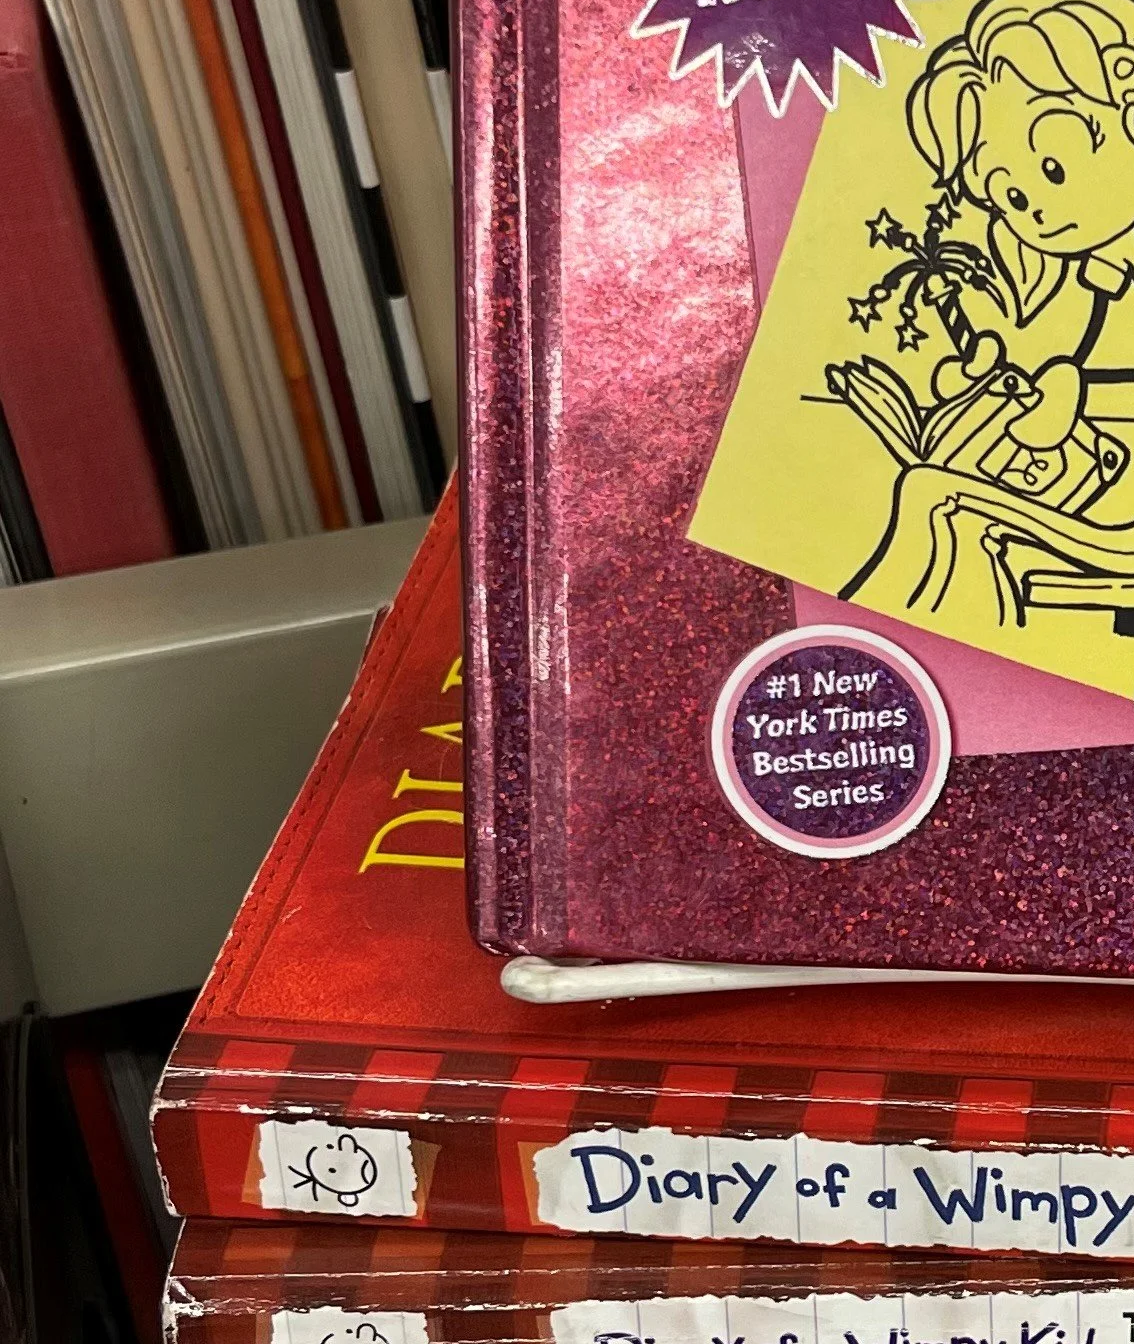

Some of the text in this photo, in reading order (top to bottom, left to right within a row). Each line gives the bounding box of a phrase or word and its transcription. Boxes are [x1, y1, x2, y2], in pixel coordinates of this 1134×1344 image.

[766, 670, 878, 698] #1 New
[746, 706, 908, 740] York Times
[752, 741, 915, 776] Bestselling
[793, 780, 884, 809] Series
[570, 1145, 777, 1224] Diary
[795, 1163, 850, 1208] of
[867, 1187, 897, 1211] a
